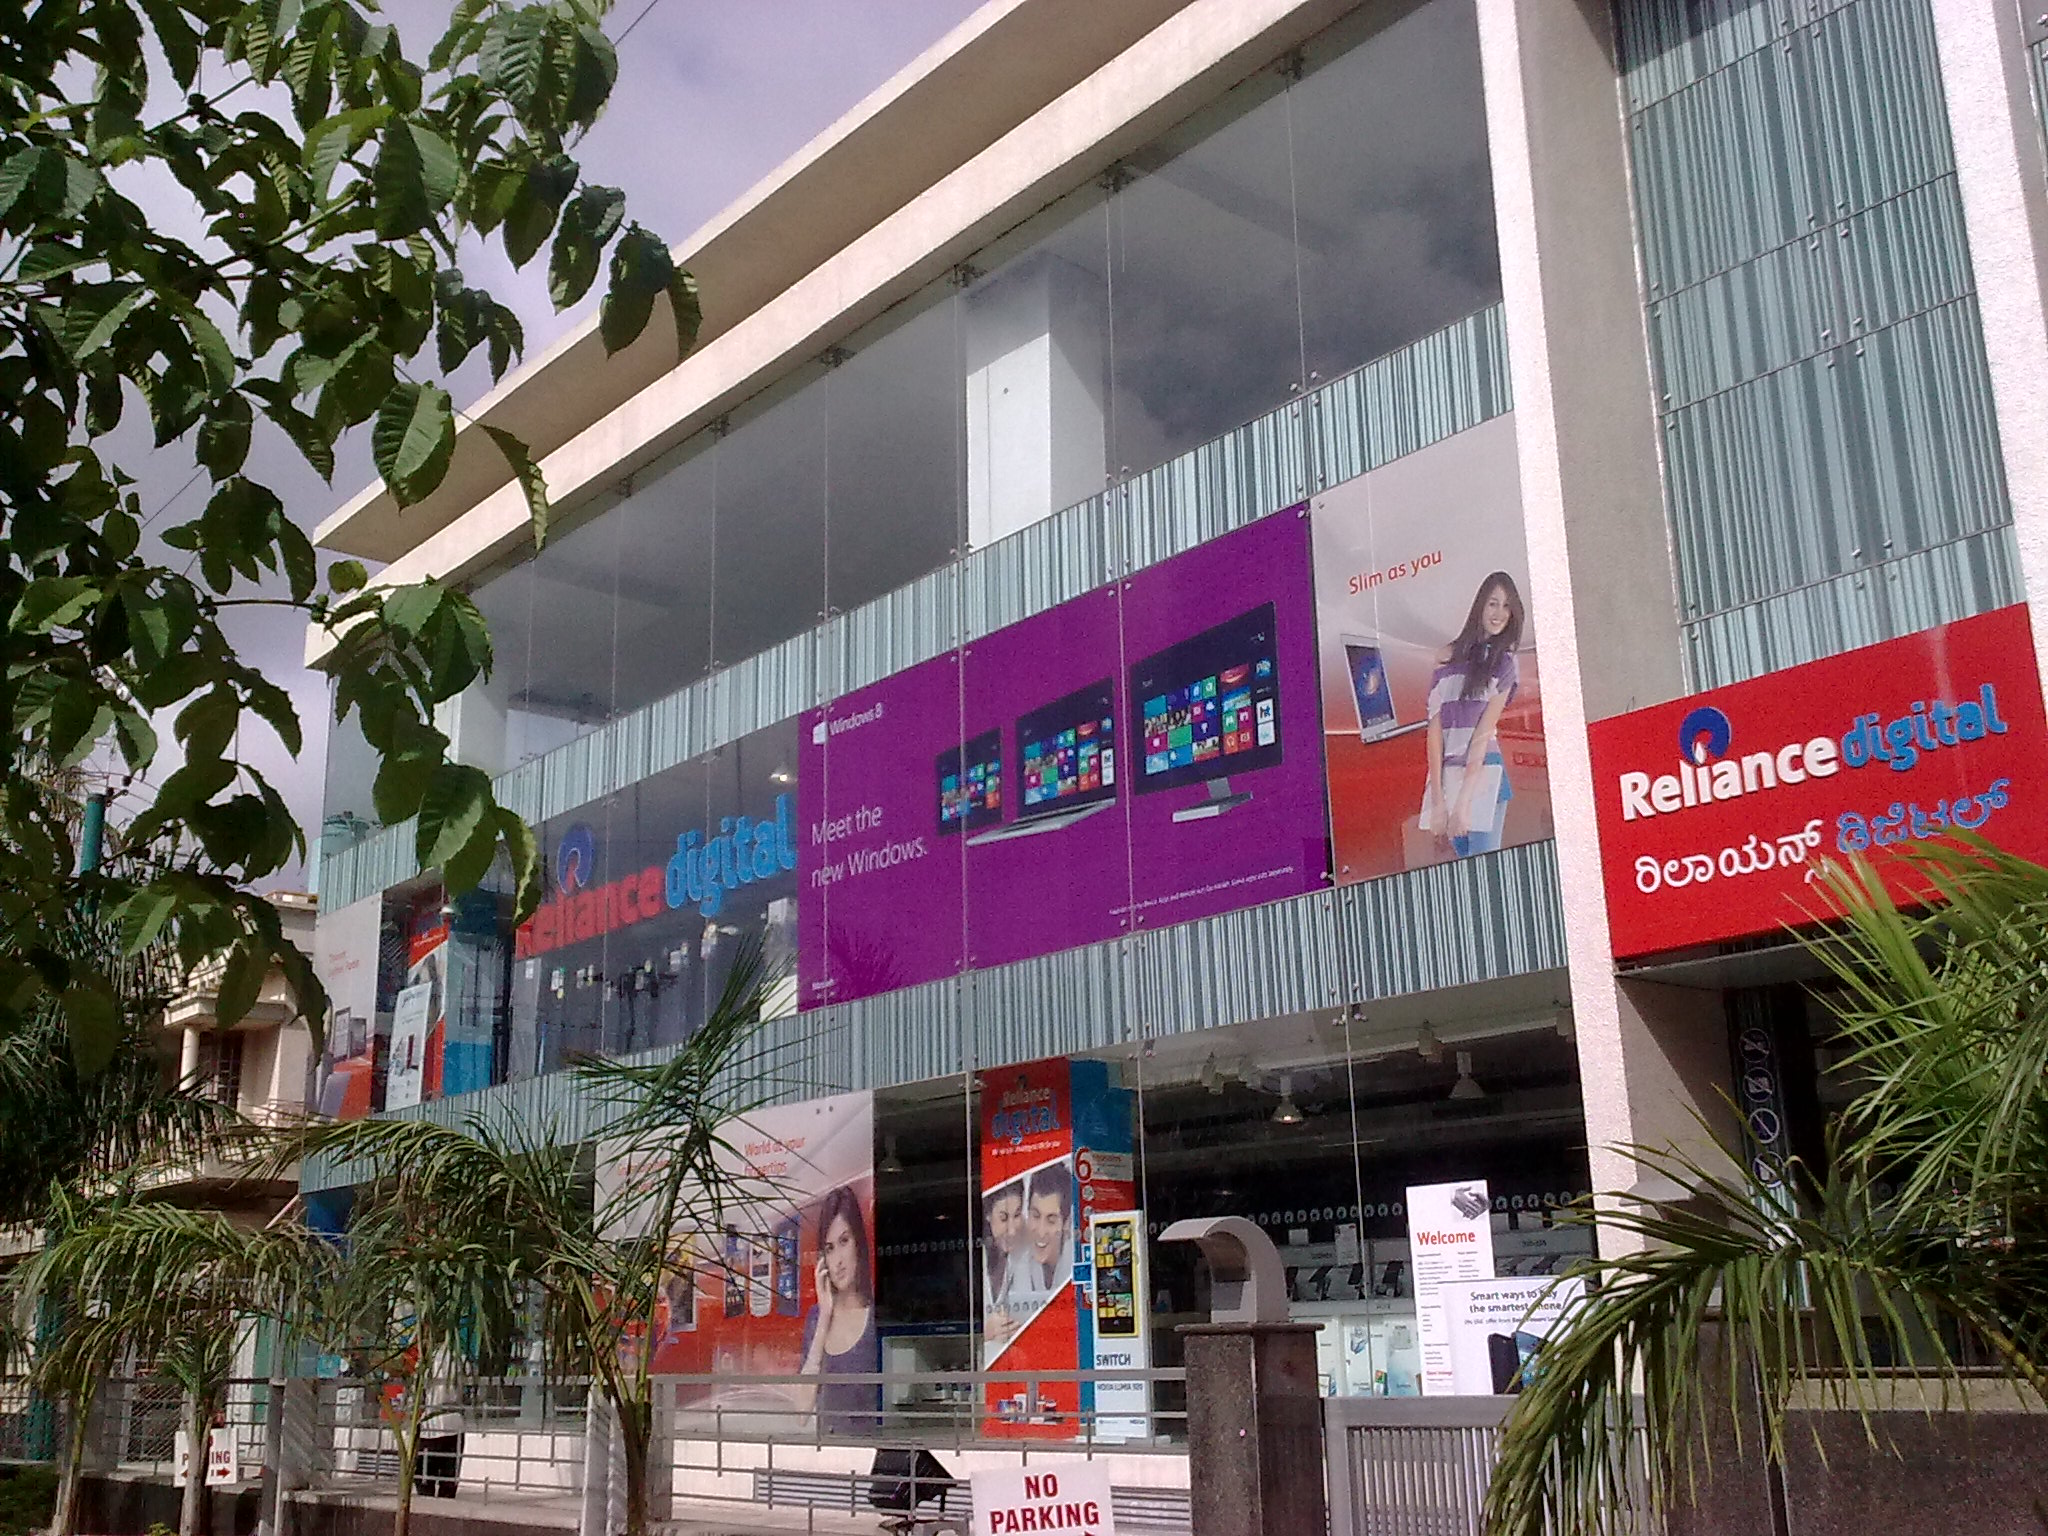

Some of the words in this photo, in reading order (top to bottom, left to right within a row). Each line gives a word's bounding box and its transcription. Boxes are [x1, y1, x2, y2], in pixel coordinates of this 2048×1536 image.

[1349, 573, 1383, 595] Slim
[1388, 563, 1407, 581] as
[1411, 550, 1442, 578] you
[829, 707, 875, 736] Windows
[874, 702, 883, 719] 8
[1619, 735, 1839, 821] Reliance
[1841, 683, 2008, 772] digital
[811, 813, 852, 847] Meet
[855, 804, 882, 833] the
[666, 793, 797, 918] digital
[811, 861, 846, 888] new
[847, 836, 928, 876] Windows.
[1003, 1086, 1051, 1106] Reliance
[991, 1090, 1061, 1146] digital
[1074, 1146, 1093, 1183] 6
[1416, 1230, 1476, 1246] Welcome
[1470, 1291, 1499, 1301] Smart
[1501, 1291, 1525, 1301] ways
[1470, 1304, 1486, 1314] the
[1487, 1302, 1529, 1313] smartest
[1096, 1354, 1132, 1367] SWITCH
[182, 1450, 231, 1466] PING
[1024, 1473, 1058, 1500] NO
[989, 1501, 1100, 1534] PARKING
